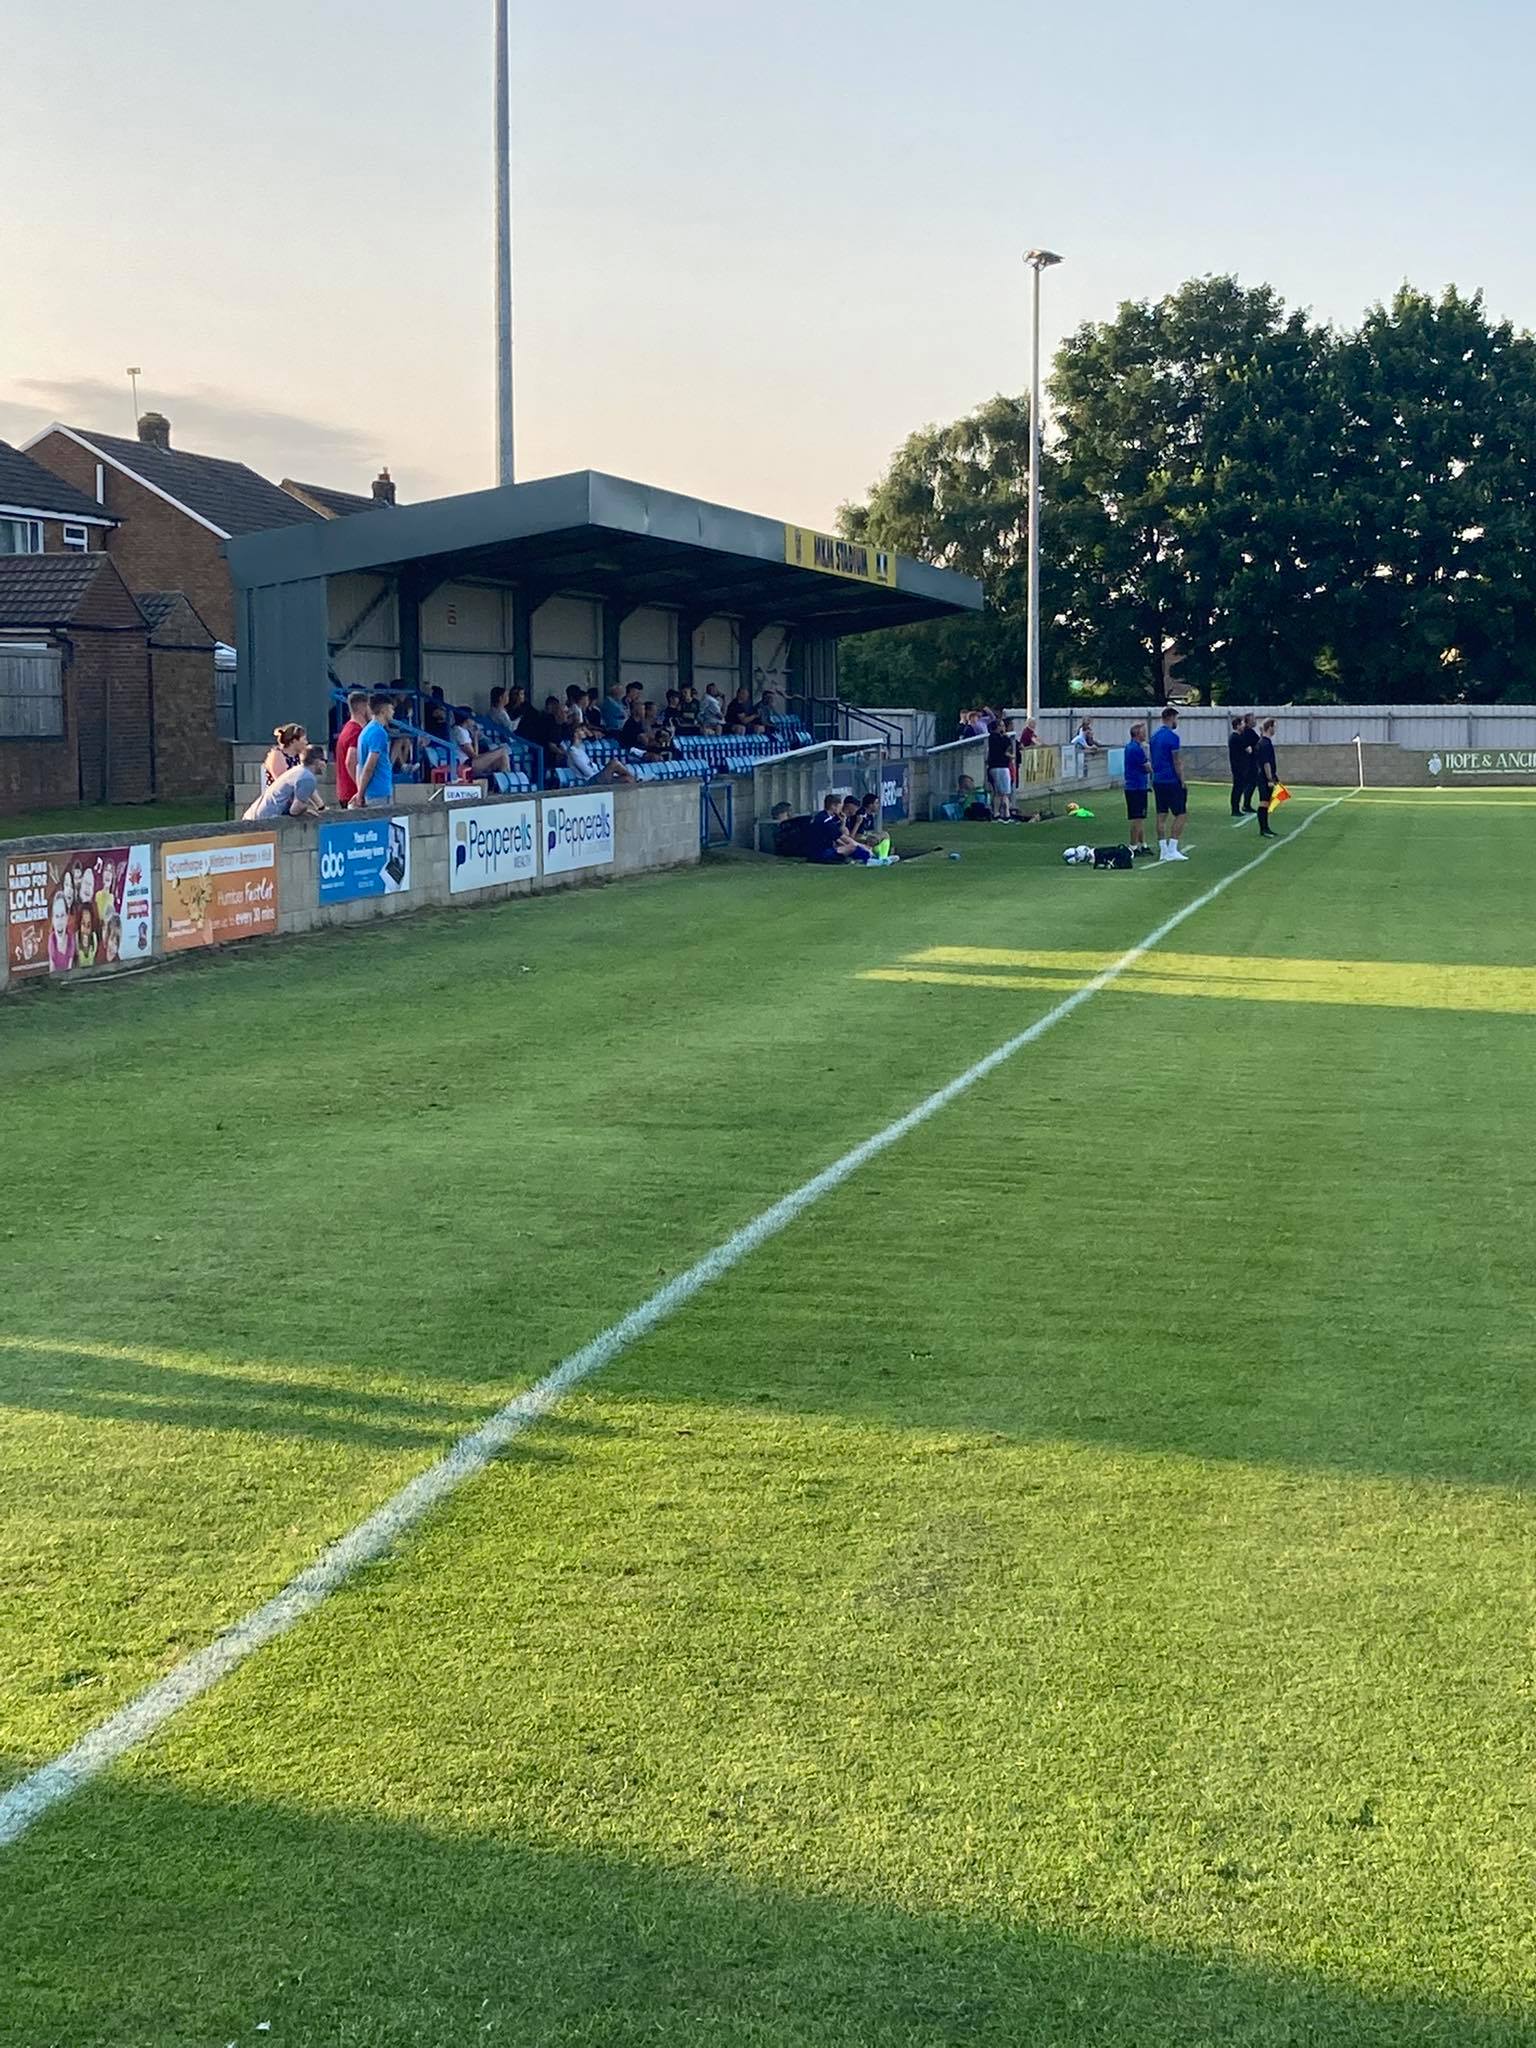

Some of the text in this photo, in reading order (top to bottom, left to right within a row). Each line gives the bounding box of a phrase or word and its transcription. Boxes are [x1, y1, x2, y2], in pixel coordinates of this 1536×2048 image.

[1446, 753, 1480, 768] HOPE
[1482, 754, 1493, 767] &
[469, 814, 532, 874] Pepperells
[558, 803, 610, 856] Pepperells
[321, 840, 344, 879] abc
[9, 888, 47, 910] LOCAL
